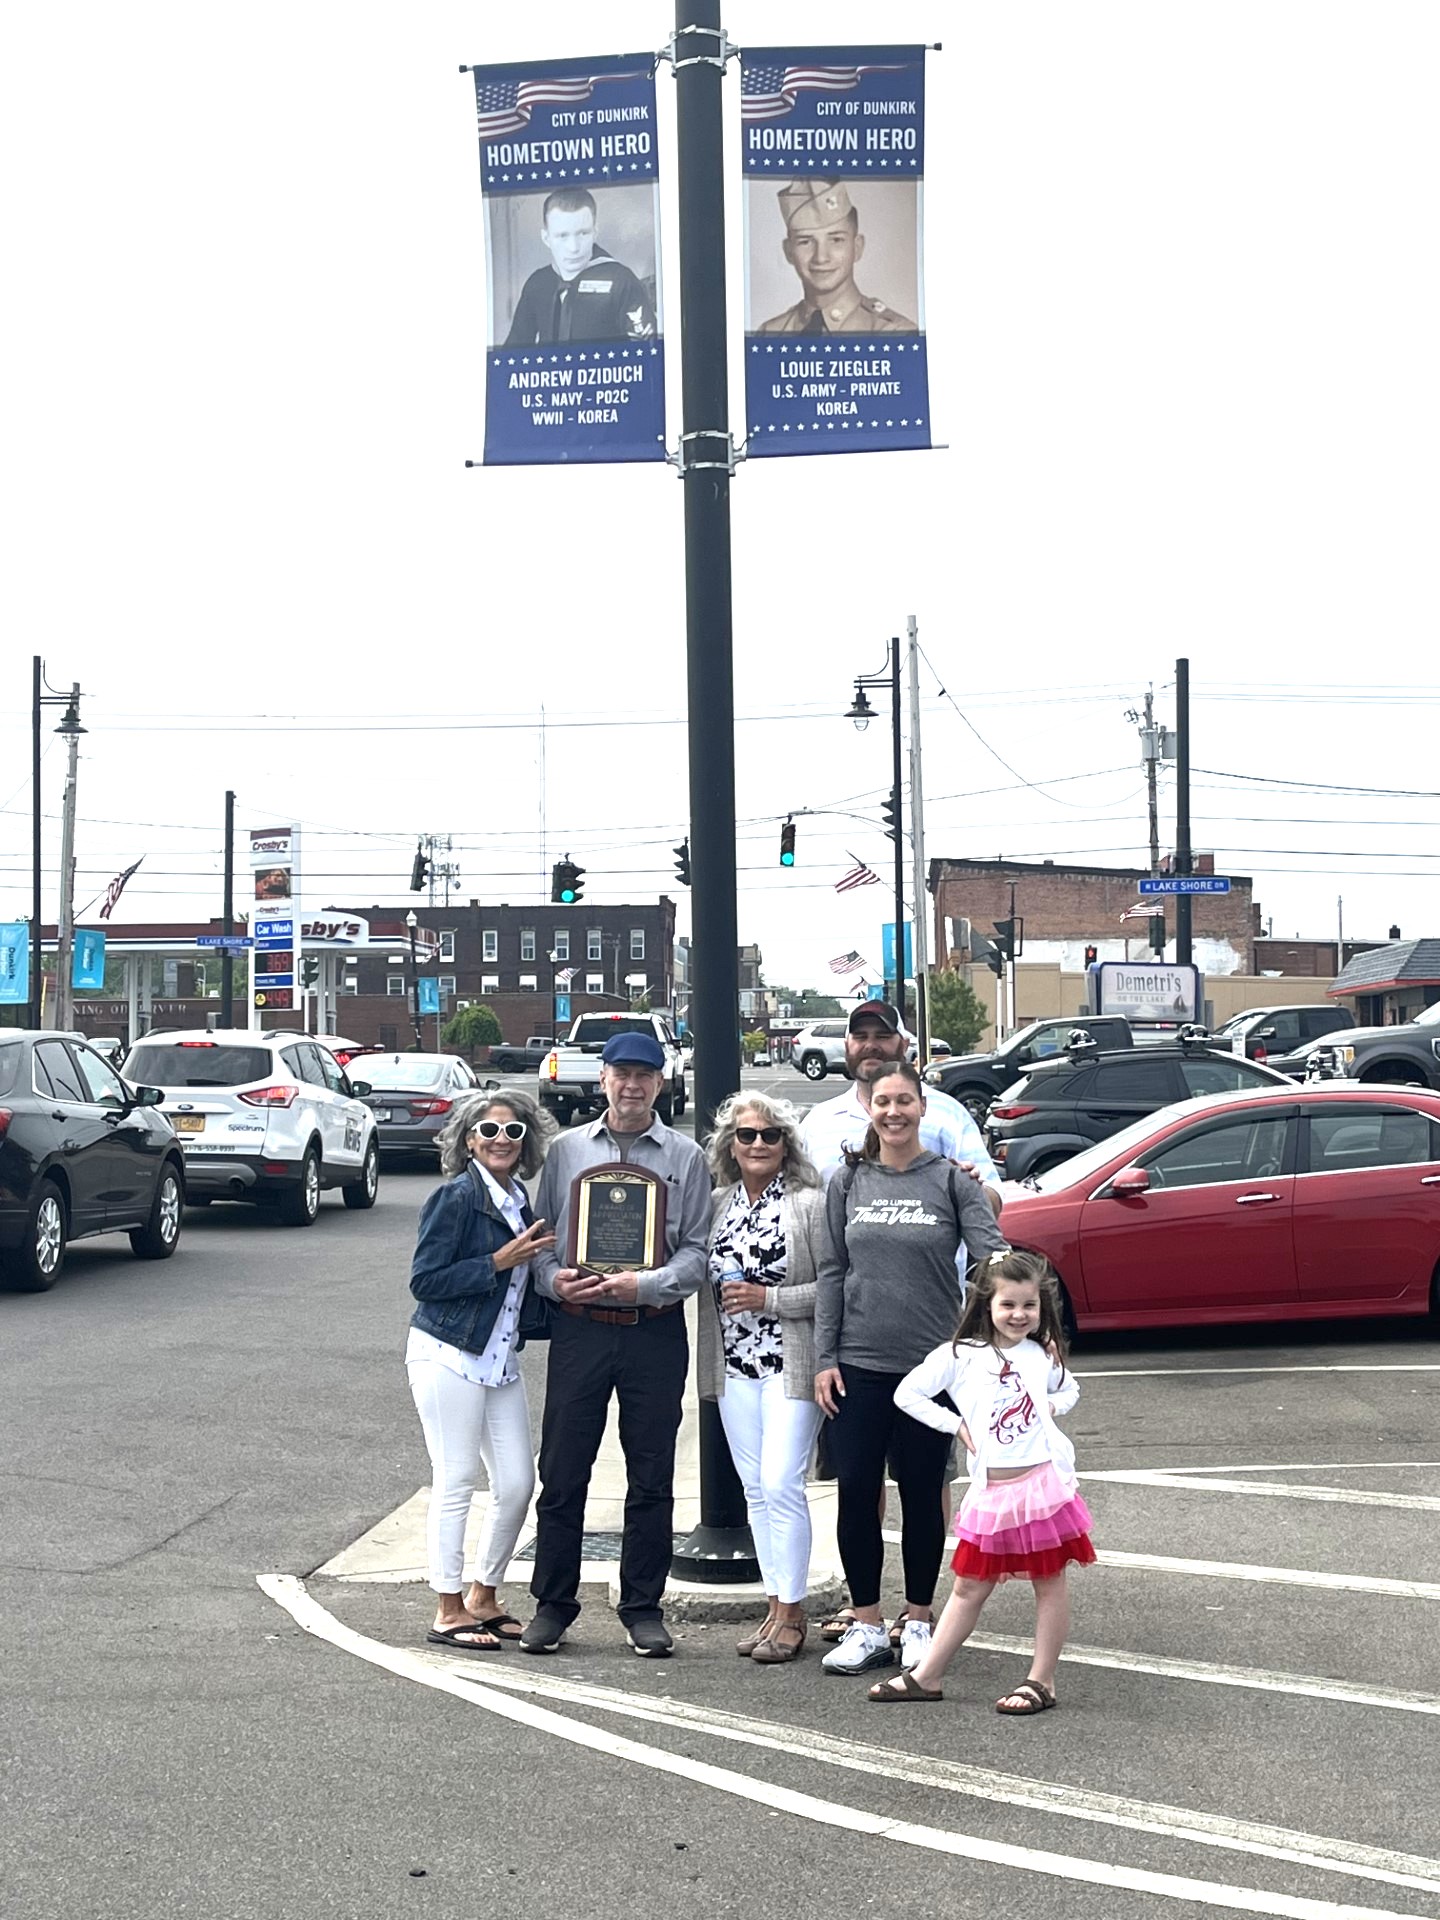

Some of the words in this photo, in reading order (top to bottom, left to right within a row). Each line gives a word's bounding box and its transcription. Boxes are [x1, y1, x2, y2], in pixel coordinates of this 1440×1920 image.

[552, 112, 576, 127] CITY
[579, 110, 594, 125] OF
[597, 106, 649, 124] DUNKIRK
[817, 101, 841, 116] CITY
[845, 101, 860, 116] OF
[863, 100, 916, 116] DUNKIRK
[749, 128, 858, 150] HOMETOWN
[866, 128, 917, 150] HERO
[487, 137, 594, 167] HOMETOWN
[602, 132, 650, 157] HERO
[509, 369, 573, 389] ANDREW
[577, 365, 643, 386] DZIDUCH
[780, 361, 824, 378] LOUIE
[829, 360, 891, 377] ZIEGLER
[772, 384, 797, 399] U.S.
[801, 383, 837, 398] ARMY
[850, 381, 901, 396] PRIVATE
[522, 393, 547, 408] U.S.
[551, 392, 583, 407] NAVY
[816, 401, 858, 416] KOREA
[532, 412, 563, 426] WWII
[577, 409, 619, 424] KOREA
[252, 840, 288, 852] Crosby's
[1152, 882, 1178, 891] LAKE
[1180, 881, 1213, 890] SHORE
[256, 924, 270, 936] Car
[271, 923, 292, 934] Wash
[301, 921, 361, 938] sby's
[222, 937, 243, 945] SHORE
[8, 947, 16, 980] Dunkirk
[1116, 972, 1182, 993] Demetri's
[1145, 995, 1165, 1003] LAKE
[72, 1004, 103, 1015] NING
[228, 1123, 263, 1132] Spectrum
[343, 1126, 362, 1153] NEWS
[890, 1199, 922, 1207] LUMBER
[851, 1207, 888, 1225] True
[880, 1206, 938, 1225] Value
